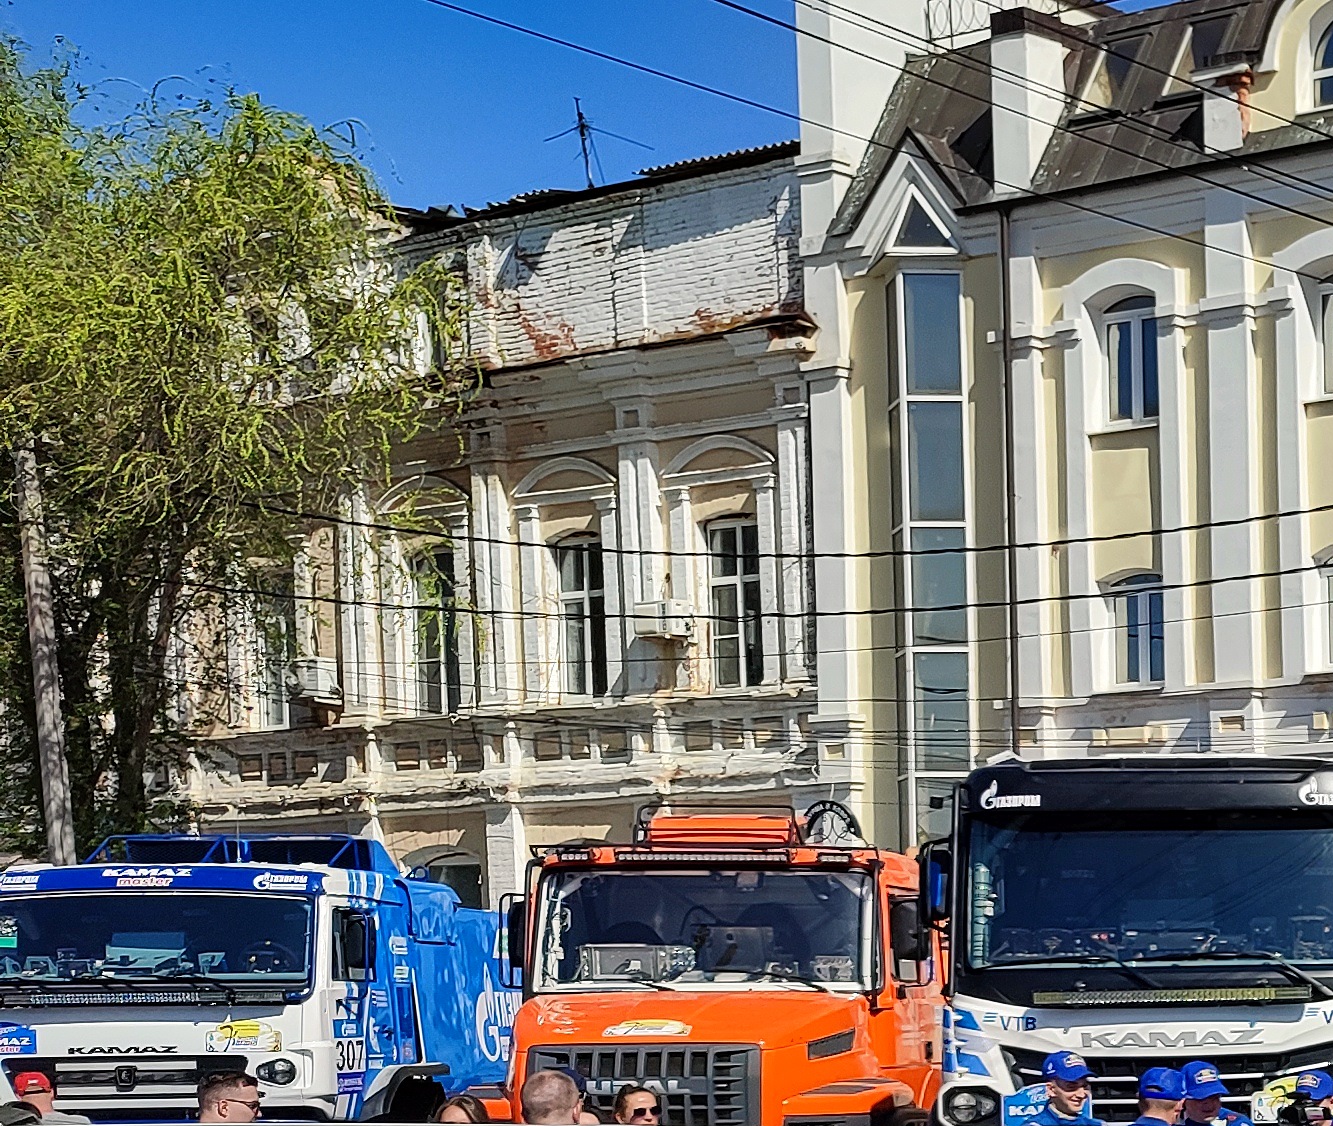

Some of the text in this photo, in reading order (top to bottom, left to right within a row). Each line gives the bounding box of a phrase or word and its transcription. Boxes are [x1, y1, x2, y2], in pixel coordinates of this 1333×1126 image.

[102, 868, 193, 878] KAMAZ
[117, 877, 173, 888] master
[1000, 1015, 1037, 1032] VTB
[1083, 1027, 1264, 1049] KAMAZ
[67, 1045, 179, 1055] KAMAZ
[336, 1039, 364, 1071] 307
